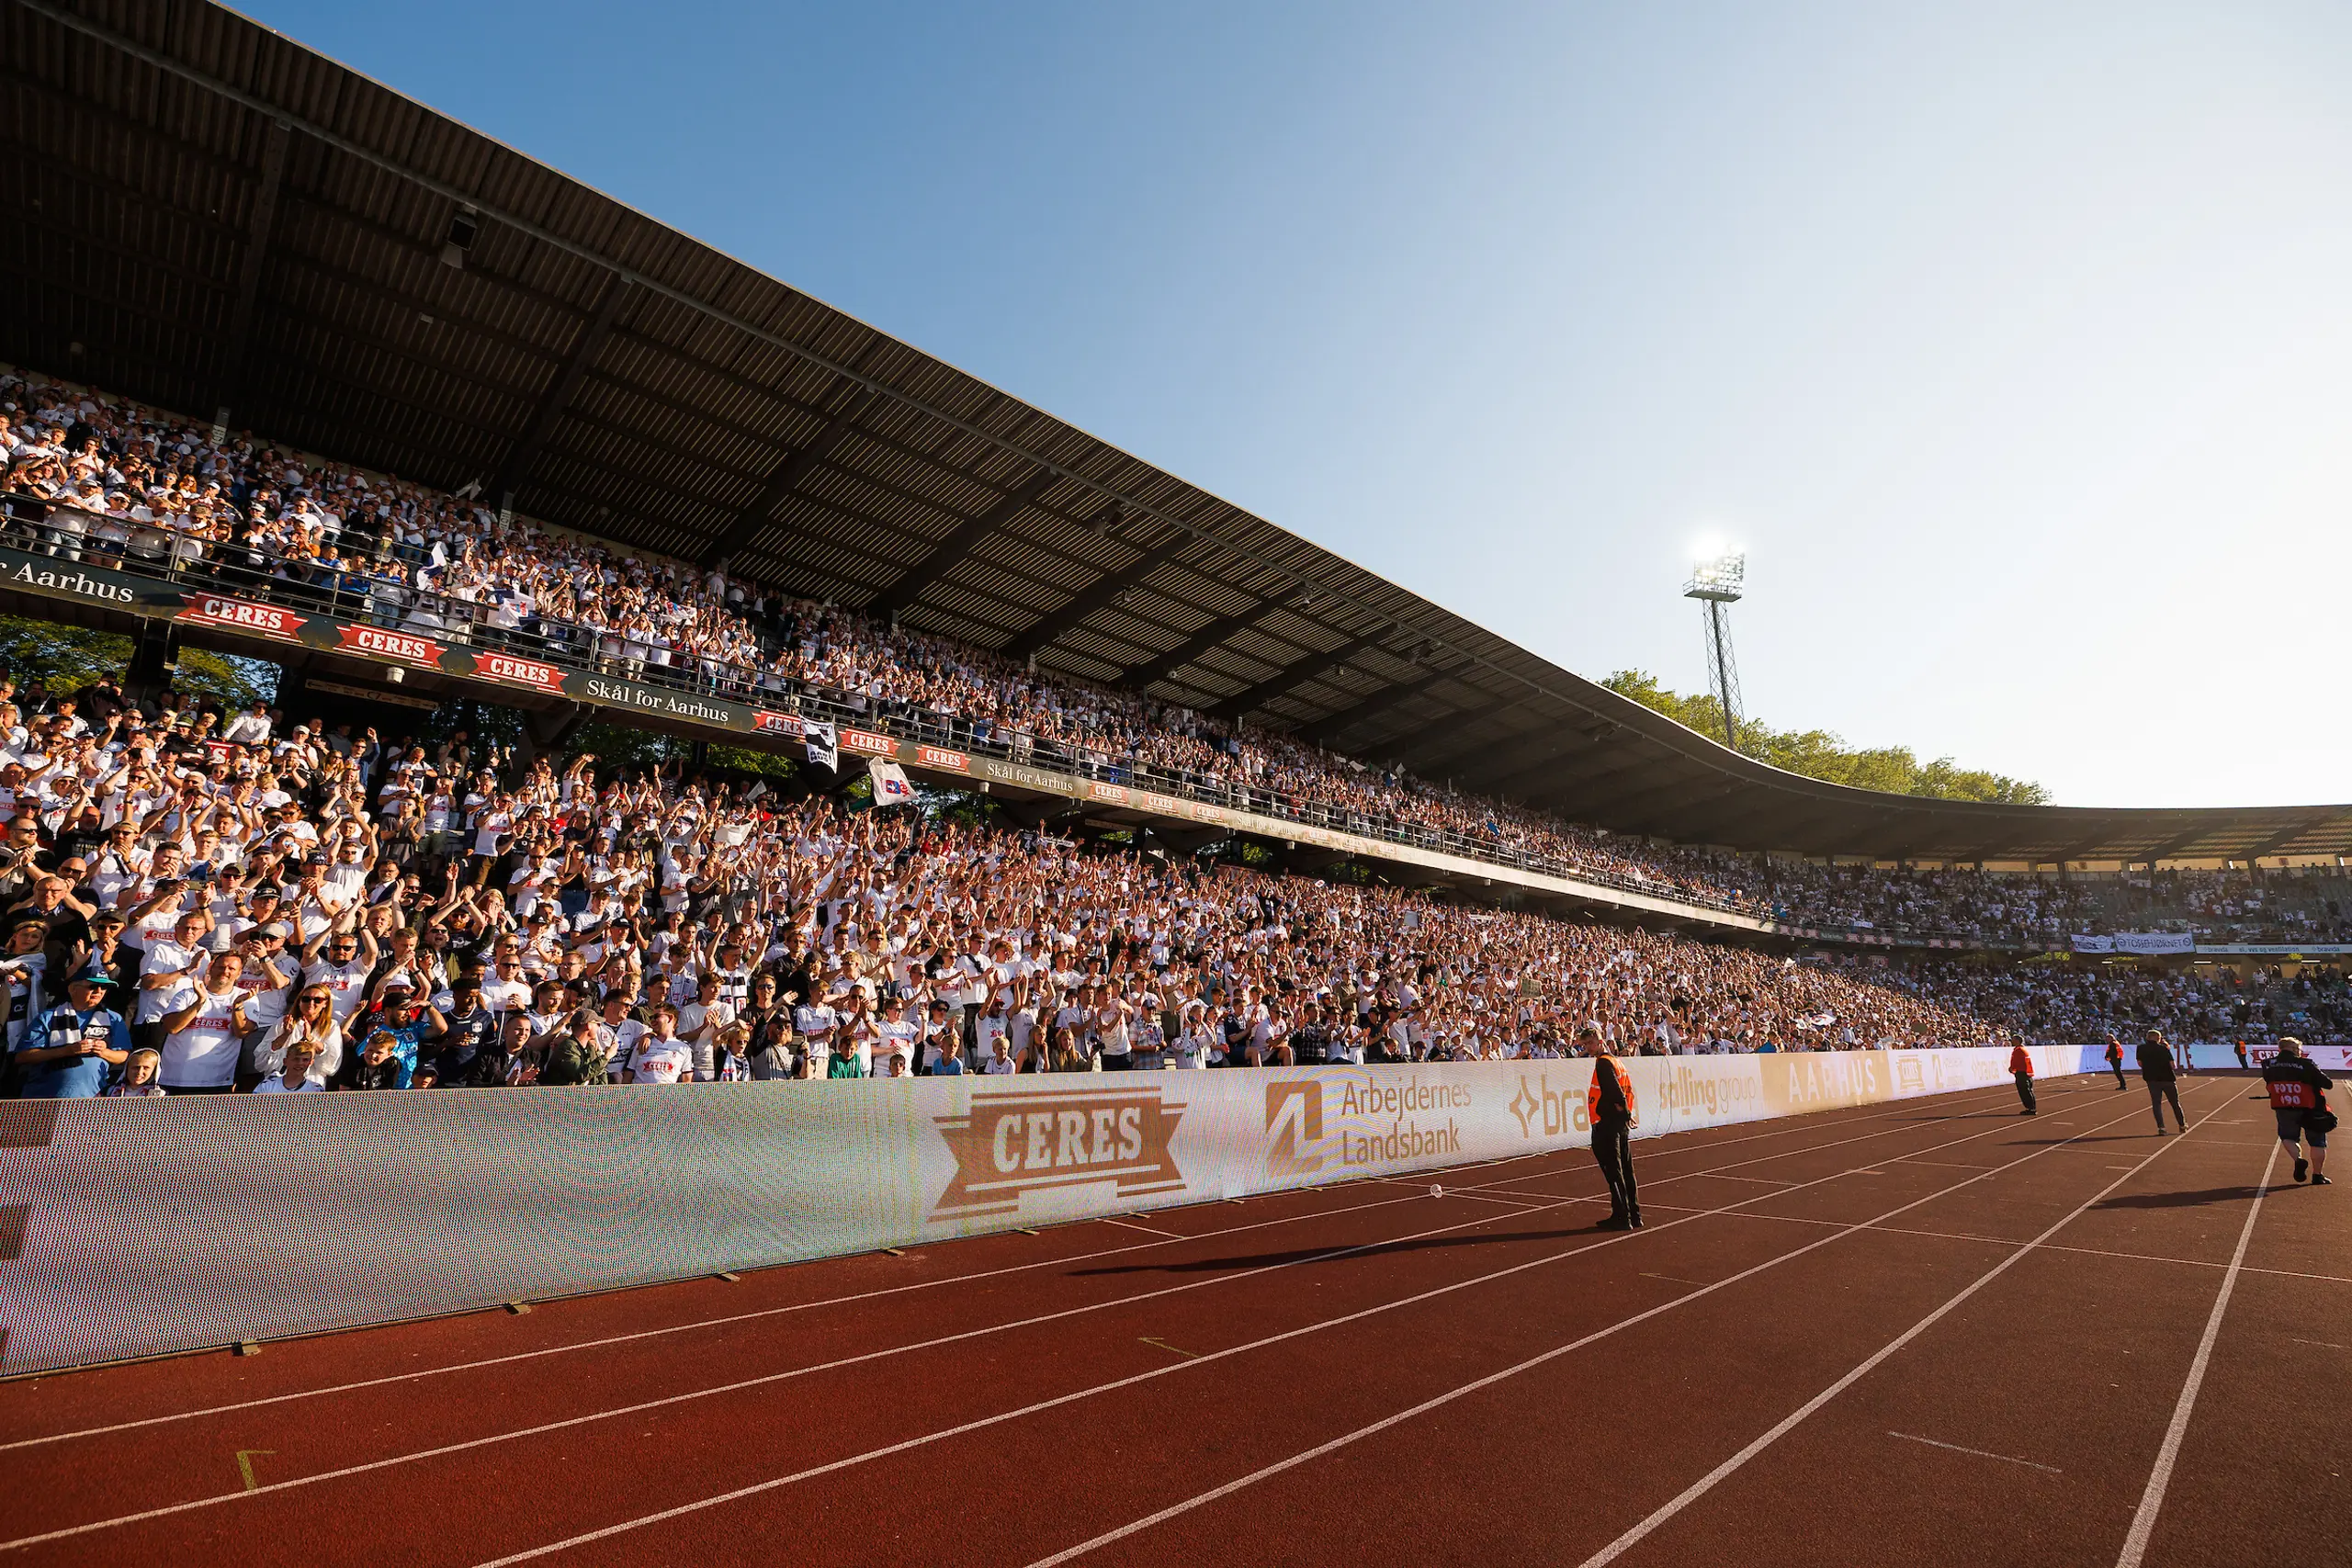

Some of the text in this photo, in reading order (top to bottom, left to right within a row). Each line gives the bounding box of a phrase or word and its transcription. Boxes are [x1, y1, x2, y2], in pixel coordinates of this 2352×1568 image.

[11, 562, 133, 603] Aarhus
[204, 600, 283, 629] CERES
[358, 630, 426, 659] CERES
[490, 658, 549, 683] CERES
[586, 680, 729, 722] Skål for Aarhus
[766, 716, 802, 734] CERE
[850, 733, 889, 752] CERES
[925, 750, 961, 766] CERES
[987, 763, 1073, 792] Skål for Aarhus
[1095, 785, 1123, 799] CERES
[1148, 795, 1173, 809] CERES
[1196, 805, 1220, 818] CERES
[1308, 829, 1329, 840] CERES
[195, 1019, 223, 1027] CERES
[2258, 1050, 2279, 1060] CER
[1659, 1066, 1756, 1115] salling group
[1789, 1057, 1876, 1103] AARHUS
[2273, 1084, 2301, 1093] FOTO
[1341, 1075, 1472, 1122] Arbejdernes
[993, 1106, 1142, 1173] CERES
[1342, 1117, 1461, 1166] Landsbank
